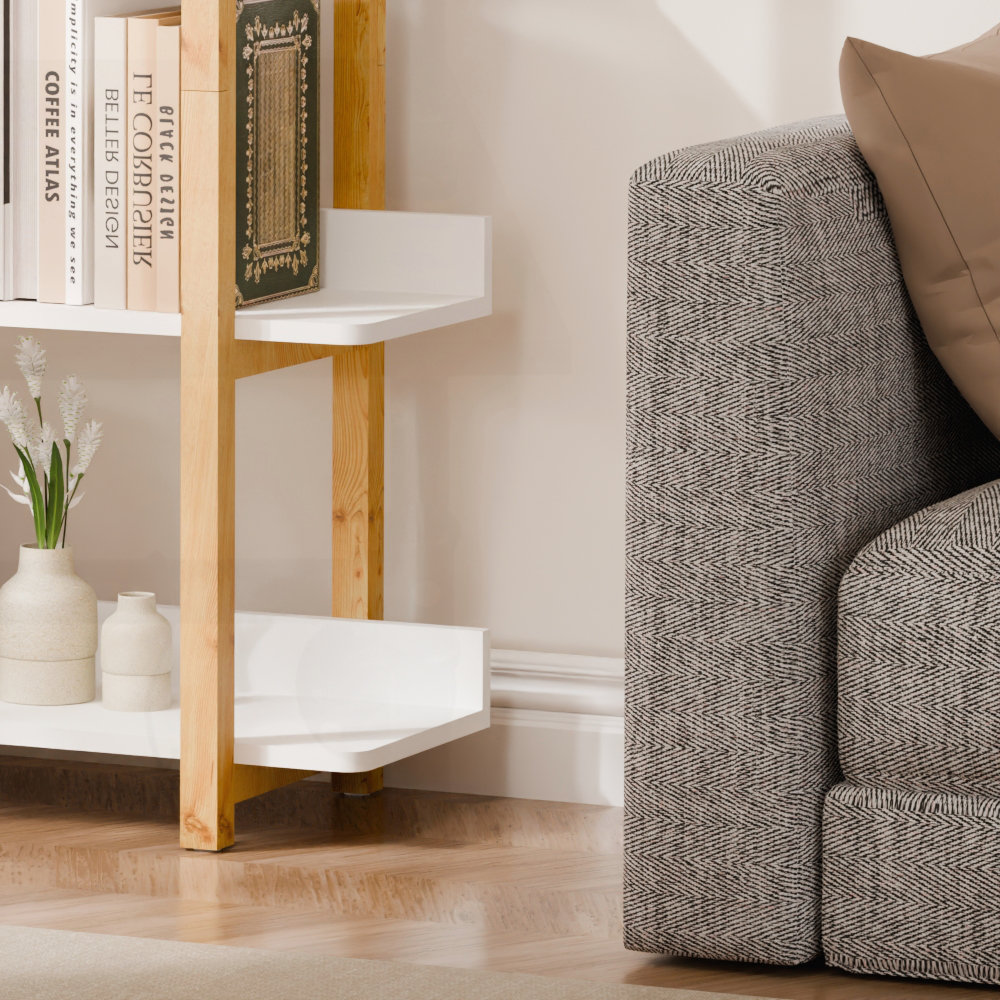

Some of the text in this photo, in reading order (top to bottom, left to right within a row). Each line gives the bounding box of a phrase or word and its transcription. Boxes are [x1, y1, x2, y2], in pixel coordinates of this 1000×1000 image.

[70, 81, 78, 95] is
[70, 103, 78, 118] in
[45, 70, 60, 202] COFFEE ATLAS
[68, 126, 78, 219] everything
[70, 227, 76, 248] we
